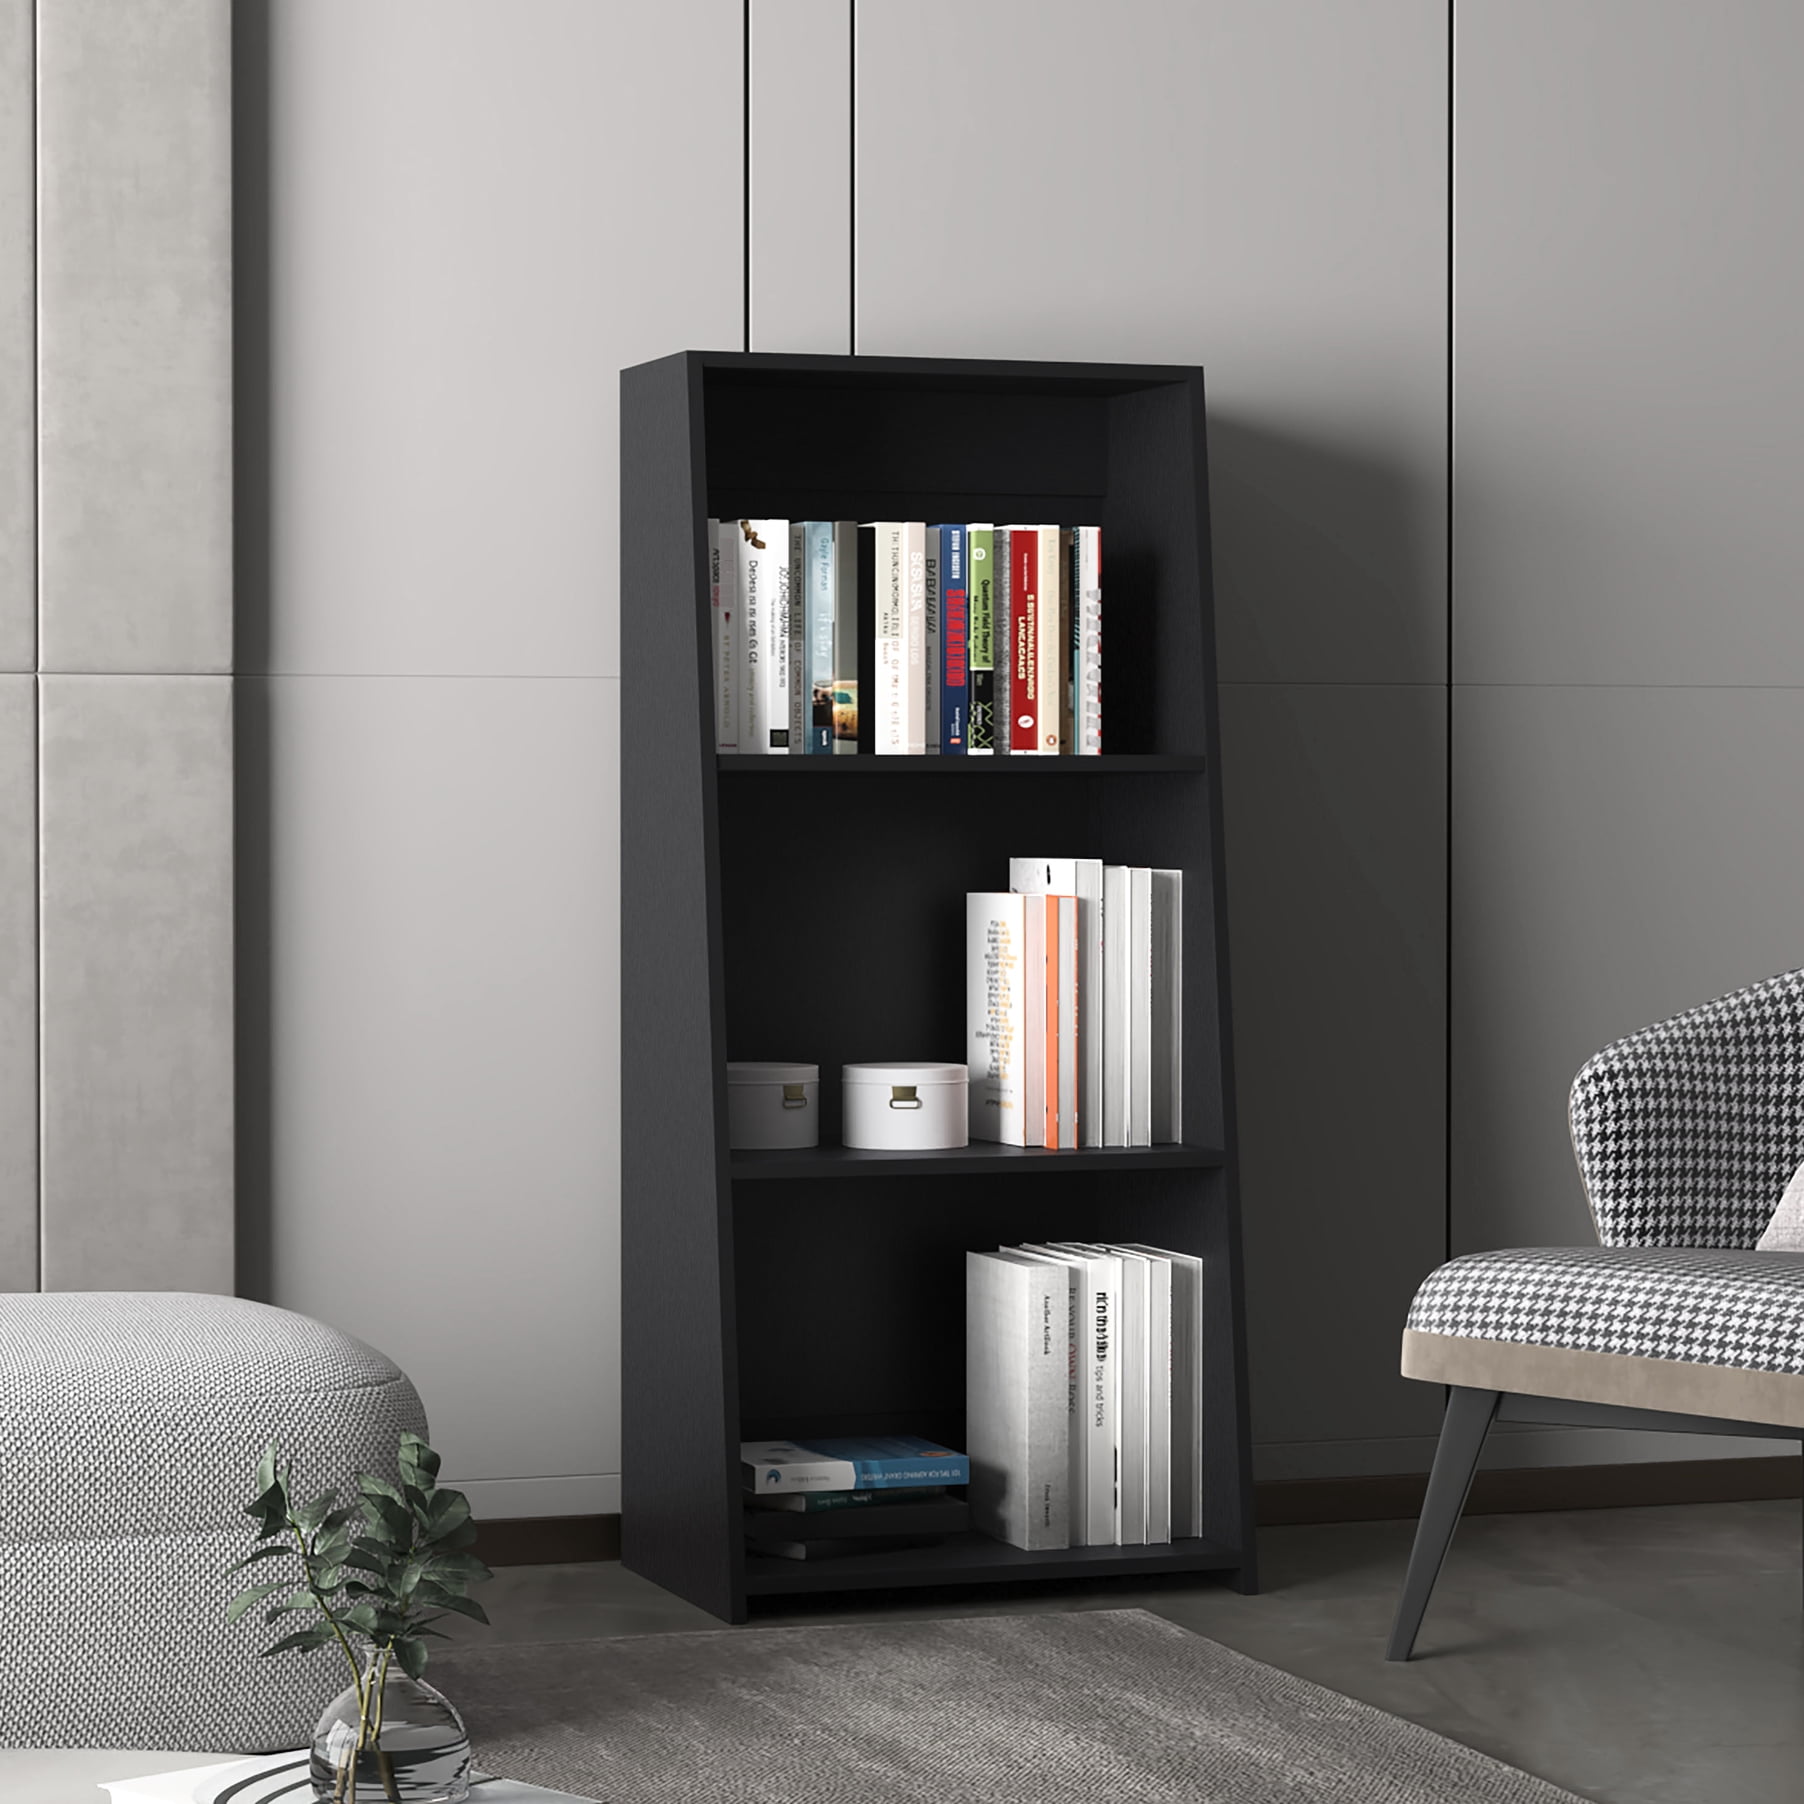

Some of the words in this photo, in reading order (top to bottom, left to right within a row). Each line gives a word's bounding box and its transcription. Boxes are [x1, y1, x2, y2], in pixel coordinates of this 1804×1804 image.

[794, 535, 802, 551] THE
[818, 537, 829, 560] Gayle
[794, 558, 802, 607] UNCOMMON
[981, 579, 991, 611] Quantum
[794, 612, 802, 637] LIFE
[982, 612, 991, 630] Field
[794, 641, 802, 653] OF
[980, 631, 991, 654] Theory
[982, 655, 991, 664] of
[794, 660, 802, 696] COMMON
[794, 702, 802, 745] OBJECTS
[1094, 1365, 1105, 1382] tips
[1095, 1384, 1105, 1401] and
[1095, 1403, 1105, 1428] tricks
